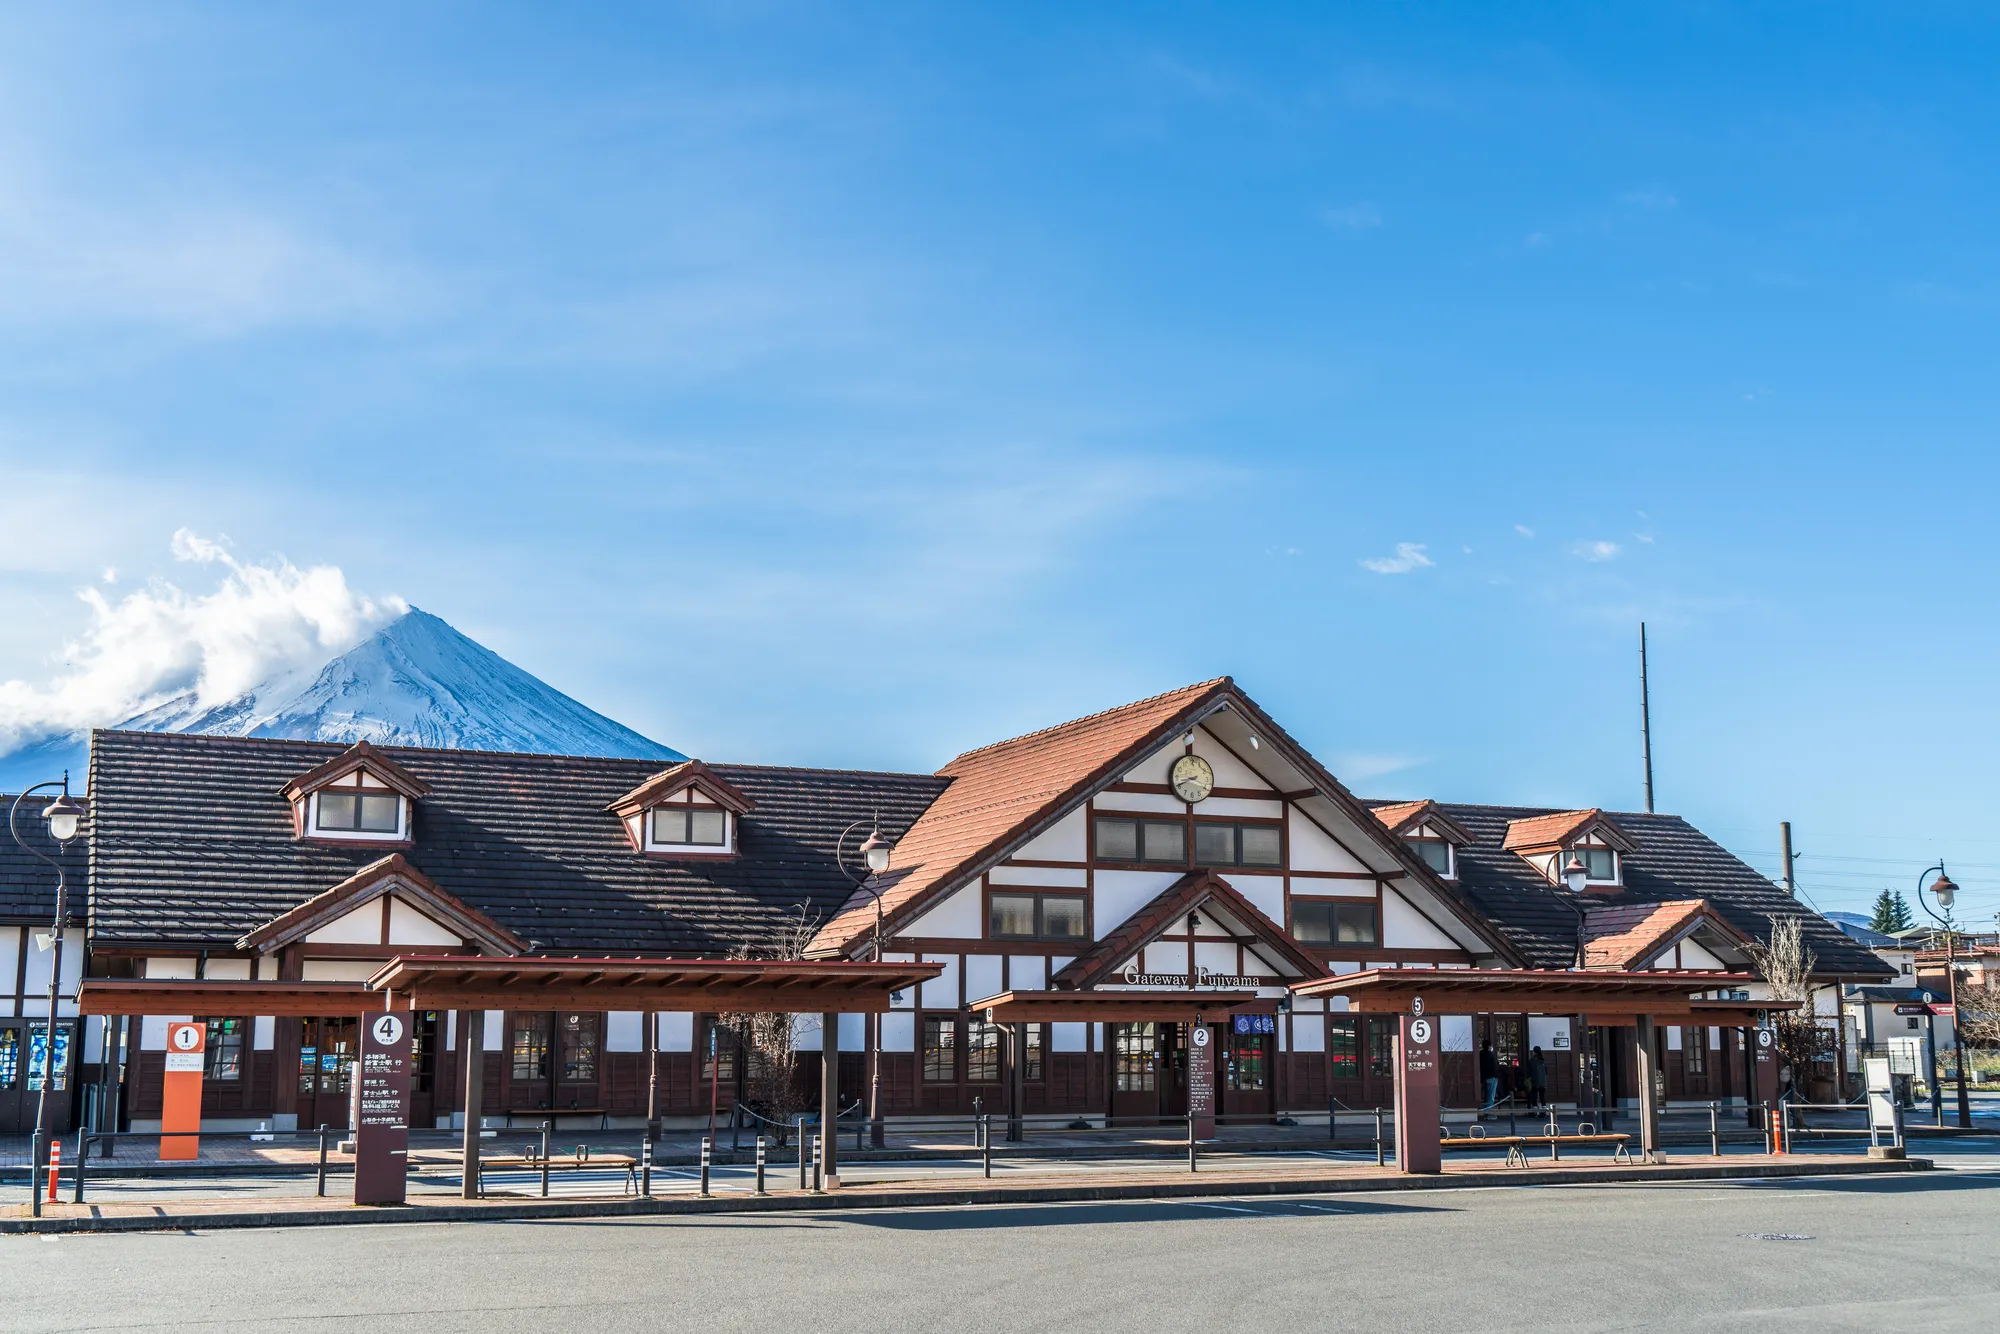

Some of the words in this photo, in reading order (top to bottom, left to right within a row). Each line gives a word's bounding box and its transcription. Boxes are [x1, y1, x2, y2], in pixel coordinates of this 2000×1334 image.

[1124, 965, 1188, 986] Gateway
[1195, 966, 1260, 987] Fujiyama
[1414, 998, 1421, 1011] 5
[380, 1018, 393, 1037] 4
[1416, 1022, 1425, 1037] 5
[182, 1029, 189, 1043] 1
[1197, 1030, 1205, 1041] 2
[1762, 1033, 1768, 1042] 3
